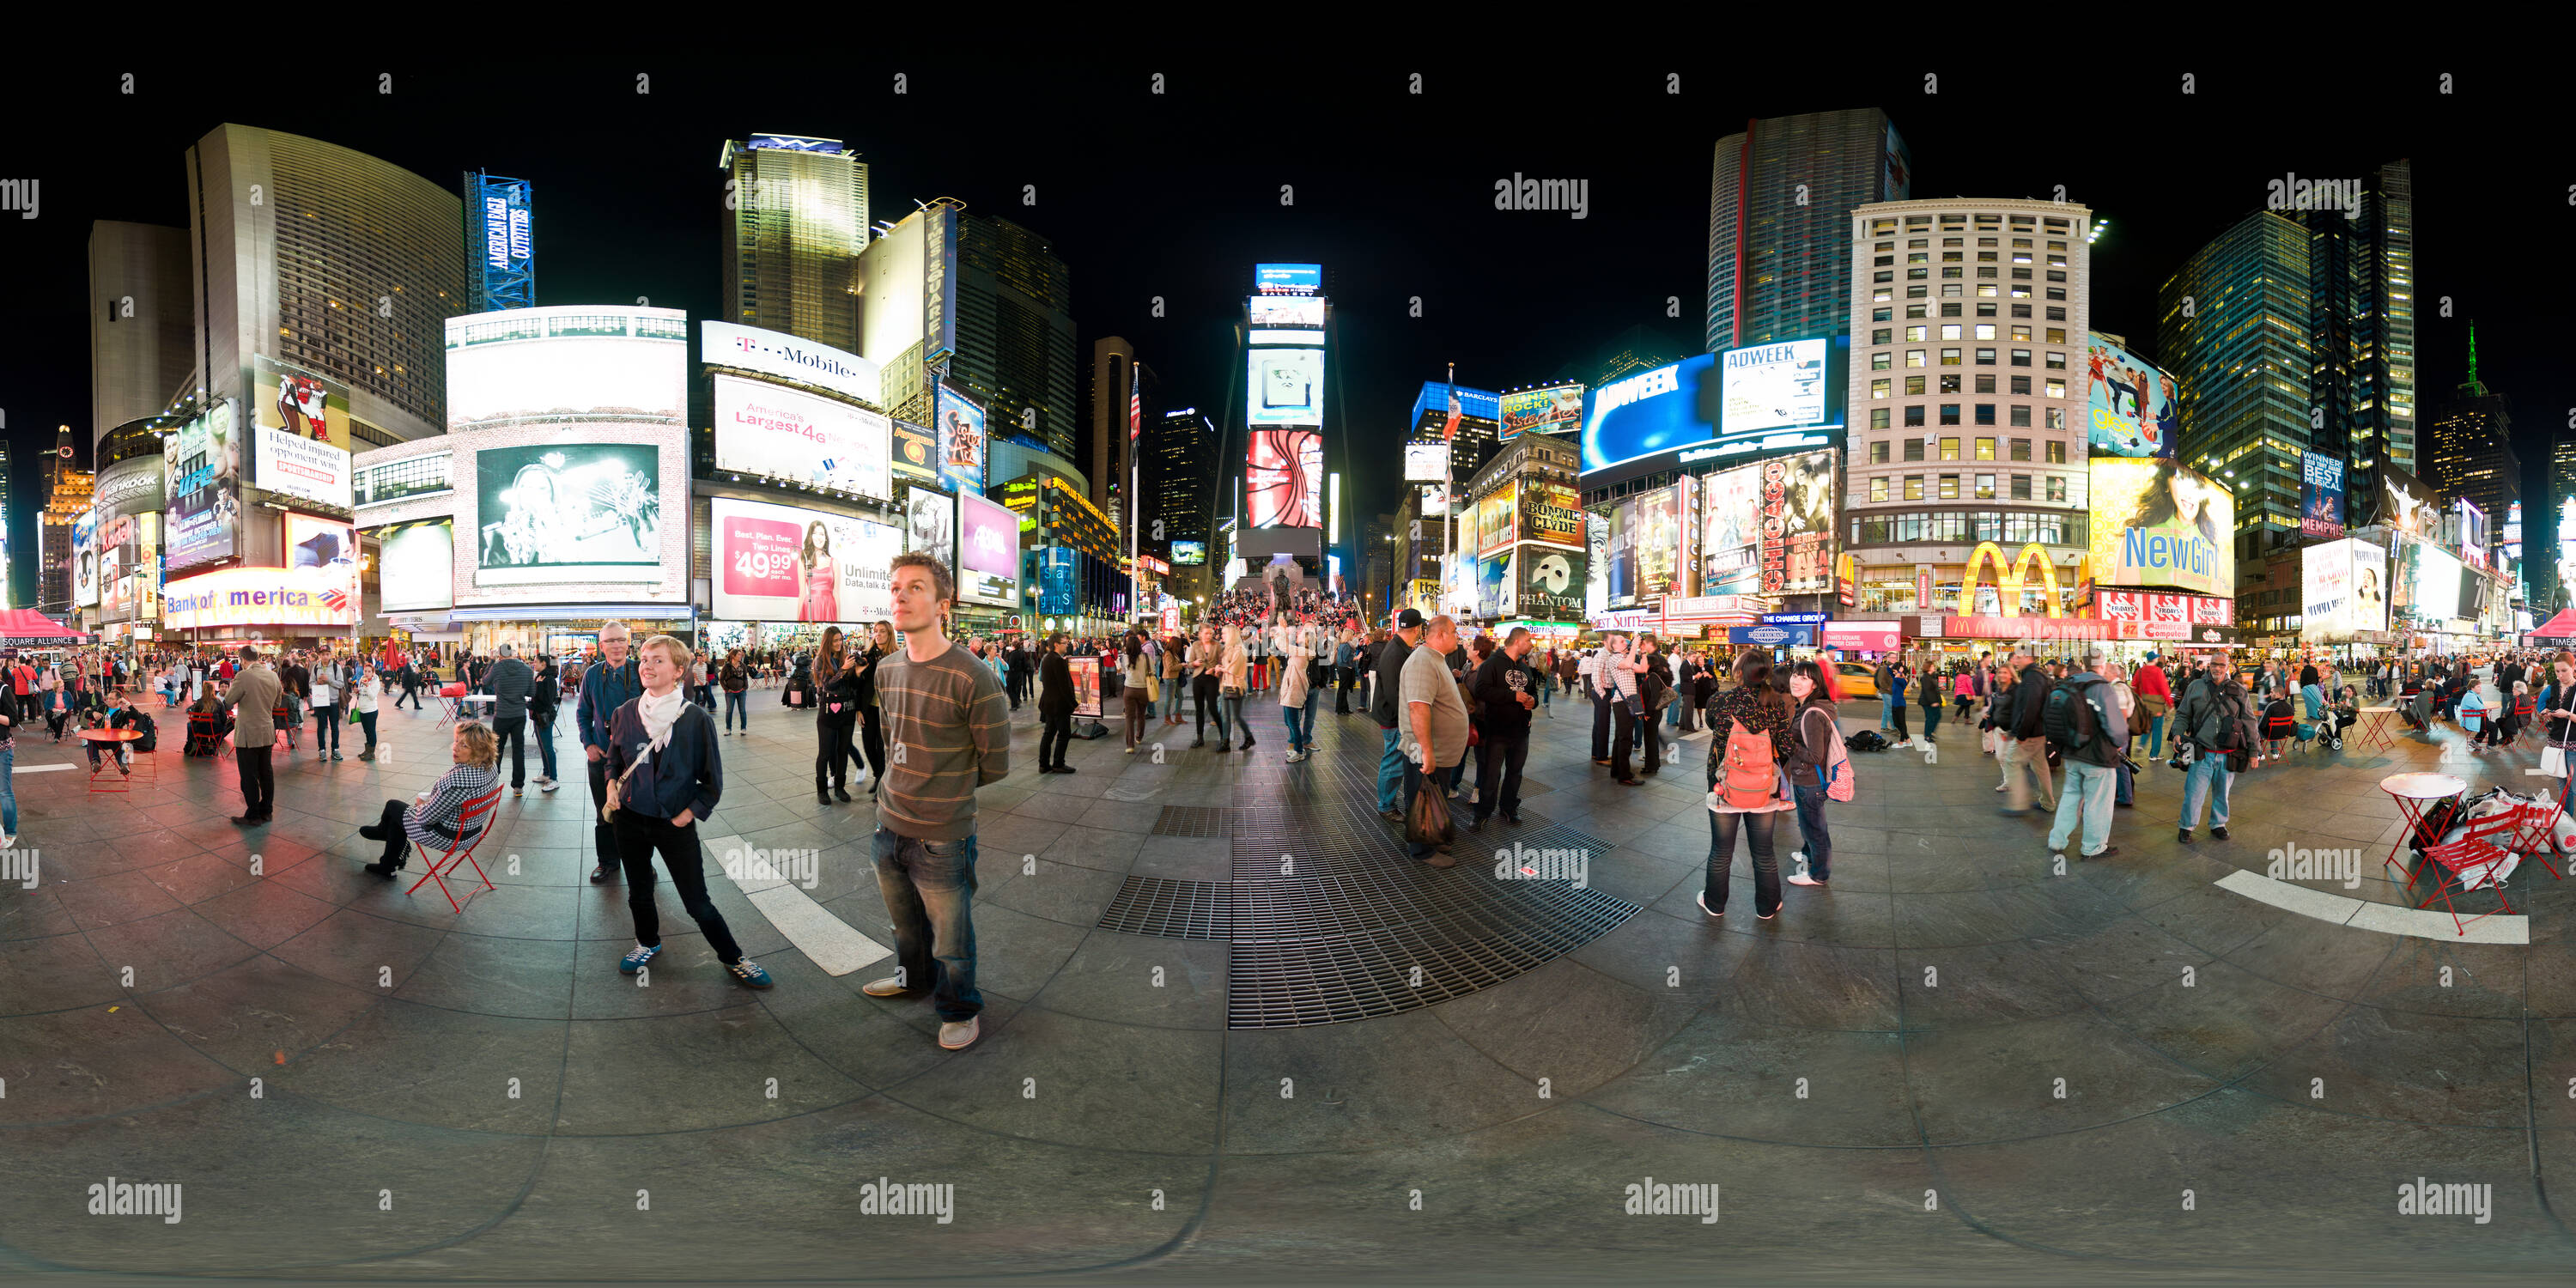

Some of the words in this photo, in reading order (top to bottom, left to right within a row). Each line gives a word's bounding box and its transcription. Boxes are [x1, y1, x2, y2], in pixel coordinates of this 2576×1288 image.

[487, 197, 507, 221] EAGLE
[509, 208, 531, 259] OUTFITTERS
[925, 212, 945, 255] TIMES
[488, 220, 508, 270] AMERICAN
[927, 260, 945, 335] SQUARE
[783, 345, 851, 380] Mobile
[1728, 344, 1795, 369] ADWEEK
[1464, 392, 1498, 403] BARCLAYS
[1595, 364, 1680, 411] ADWEEK
[1504, 391, 1548, 405] NUNS
[1504, 398, 1548, 414] ROCK!
[746, 403, 805, 422] America's
[1166, 410, 1187, 418] Allianz
[1503, 410, 1545, 429] Sister
[1542, 404, 1580, 424] Act
[736, 411, 799, 434] Largest
[802, 424, 826, 444] 4G
[945, 409, 982, 448] Sister
[2093, 408, 2135, 438] glee
[270, 431, 307, 451] Helped
[308, 443, 340, 461] injured
[894, 427, 936, 447] Avenue
[270, 446, 319, 465] opponent
[320, 459, 340, 471] win.
[903, 439, 927, 466] Q
[948, 435, 978, 465] Act
[2302, 450, 2343, 469] WINNER!
[178, 464, 214, 498] UFC
[278, 462, 334, 483] SPORTSMANSHIP
[2304, 464, 2342, 484] BEST
[2304, 476, 2342, 492] MUSICAL
[1005, 495, 1036, 507] Bloomberg
[1527, 502, 1582, 522] BONNIE
[1532, 516, 1577, 534] CLYDE
[1690, 483, 1699, 572] PALACE
[1763, 462, 1786, 592] CHICAGO
[2301, 517, 2344, 537] MEMPHIS
[734, 530, 754, 539] Best.
[755, 532, 775, 543] Plan.
[775, 533, 793, 544] Ever.
[1481, 530, 1499, 550] JERSEY
[1499, 525, 1513, 544] BOYS
[1785, 532, 1828, 546] AMERICAN
[752, 543, 769, 552] Two
[770, 543, 791, 554] Lines
[1546, 547, 1562, 556] belongs
[1793, 542, 1820, 554] IDOL'S
[2126, 526, 2189, 571] New
[2191, 536, 2219, 580] Girl
[1707, 550, 1758, 575] PRISCILLA
[845, 564, 892, 582] Unlimite
[866, 580, 880, 590] talk
[881, 581, 887, 591] &
[1419, 580, 1440, 593] tbs
[167, 593, 197, 613] Bank
[199, 590, 214, 609] of
[225, 586, 308, 606] merica
[1519, 594, 1581, 608] PHANTOM
[772, 623, 806, 634] GRAND
[1763, 614, 1775, 623] THE
[1775, 614, 1801, 623] CHANGE
[1801, 614, 1826, 623] GROUP
[2123, 625, 2136, 635] 47
[3, 637, 35, 646] SQUARE
[37, 637, 73, 646] ALLIANCE
